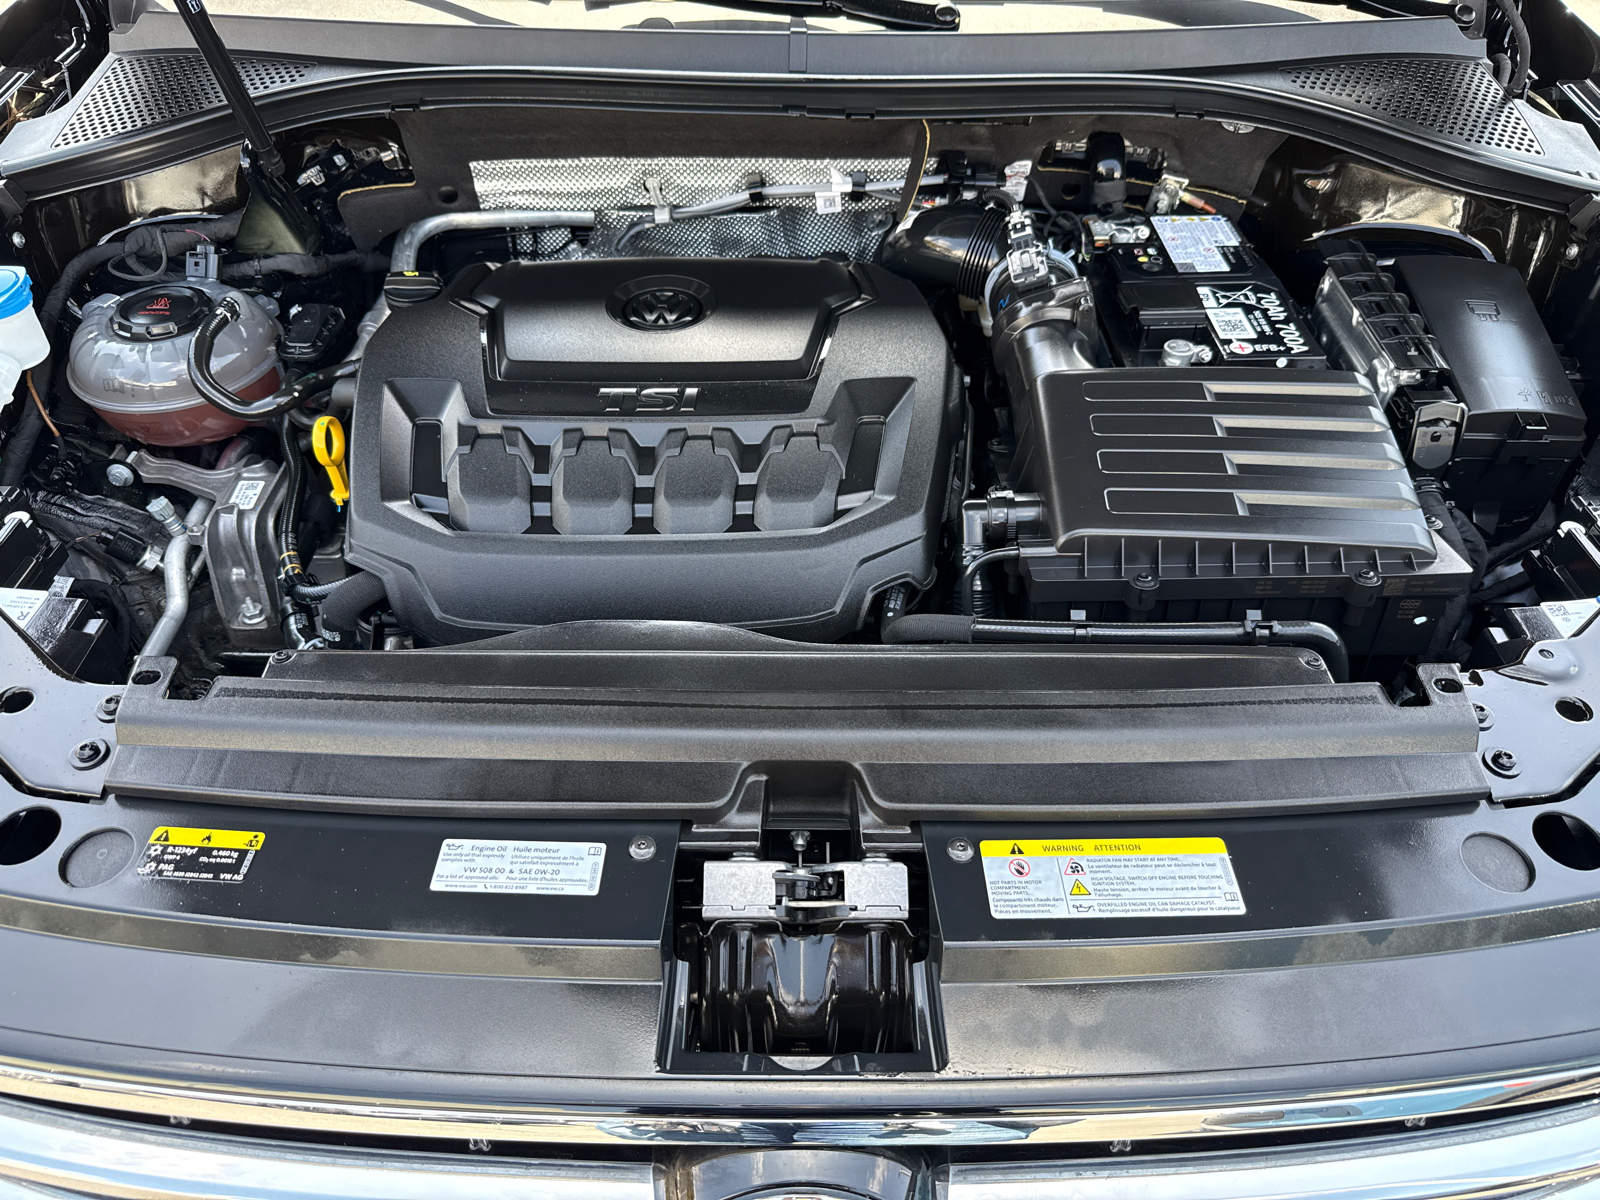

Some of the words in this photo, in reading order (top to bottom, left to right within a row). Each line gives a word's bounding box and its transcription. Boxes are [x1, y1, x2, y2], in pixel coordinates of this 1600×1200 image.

[1257, 292, 1288, 321] 70Ah
[1275, 323, 1309, 354] 700A
[598, 387, 700, 412] TSI
